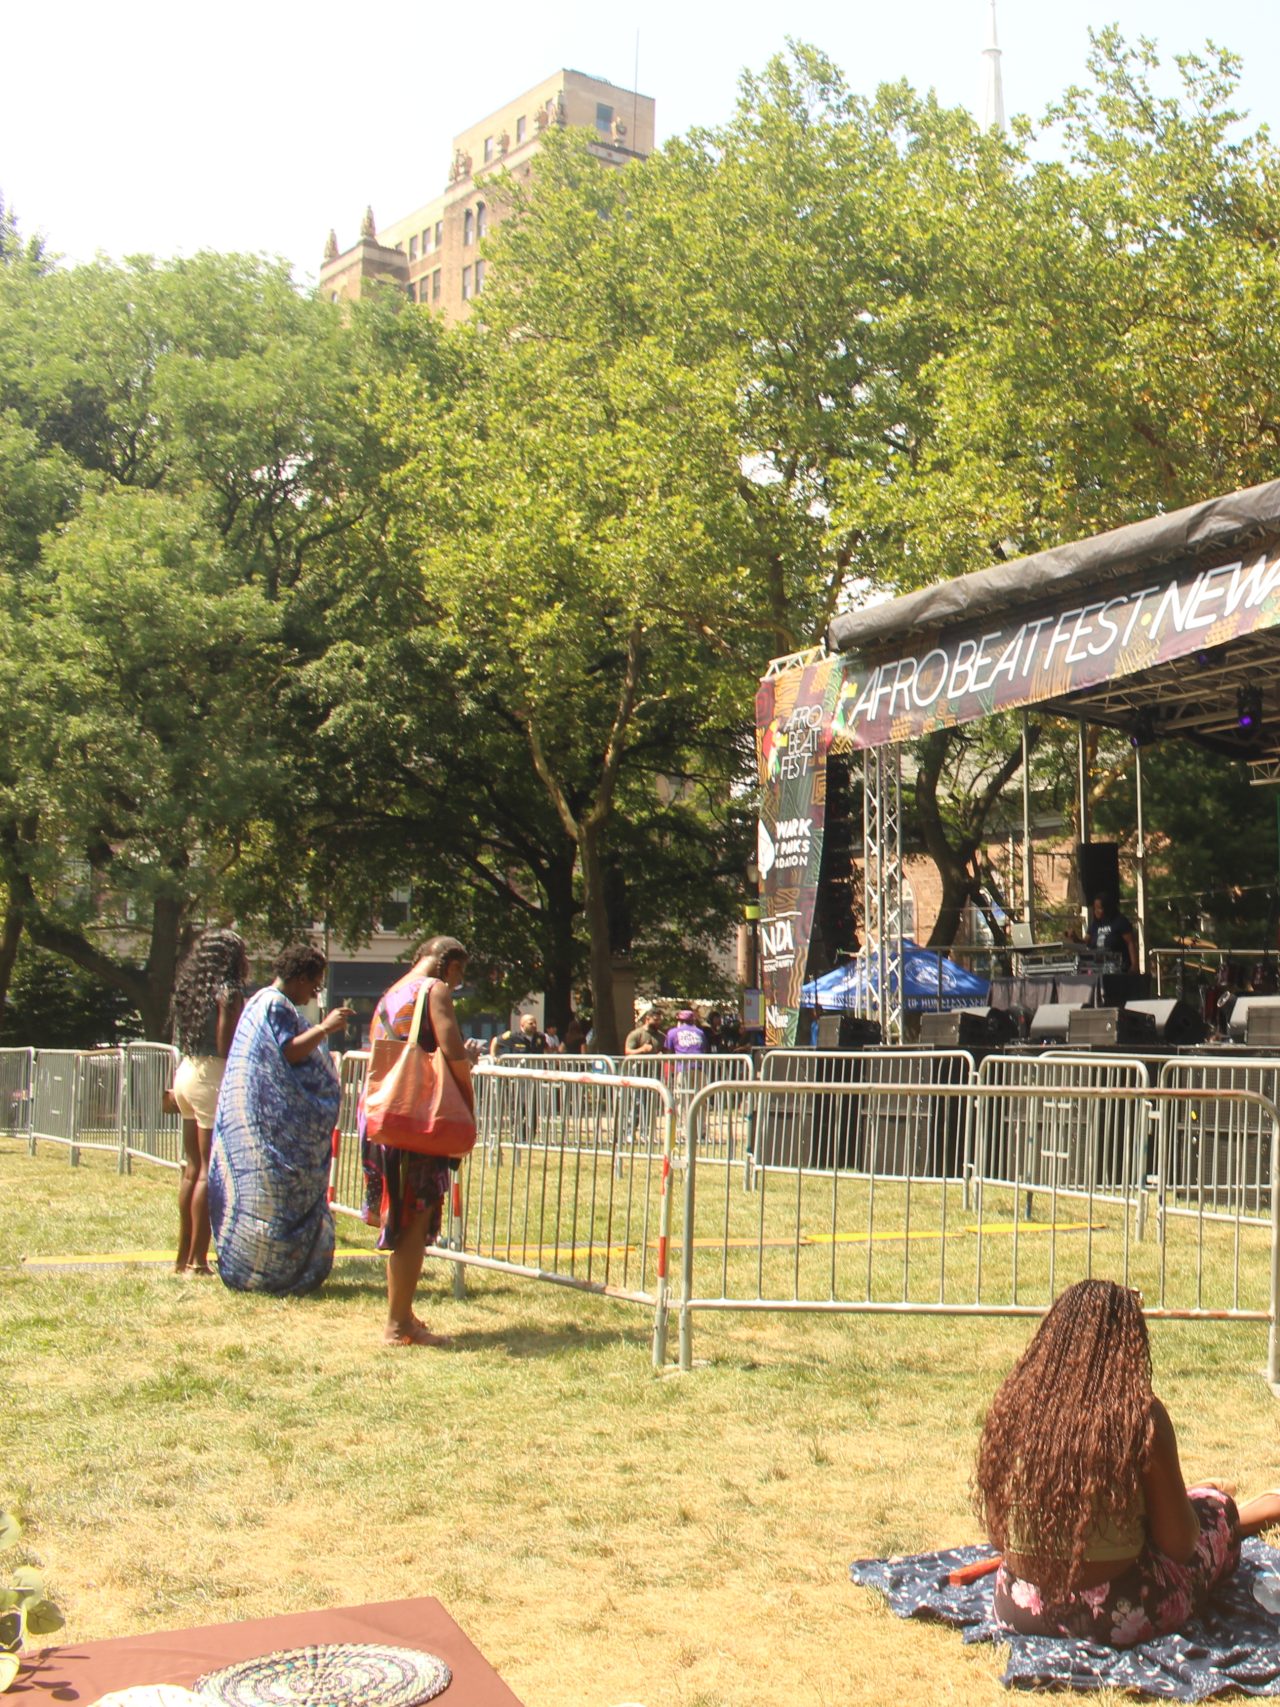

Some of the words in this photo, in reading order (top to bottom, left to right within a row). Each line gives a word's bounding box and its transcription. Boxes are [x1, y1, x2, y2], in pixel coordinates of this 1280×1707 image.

[783, 704, 823, 732] AFRO
[787, 727, 822, 756] BEAT
[780, 753, 812, 780] FEST
[776, 818, 813, 839] WARK
